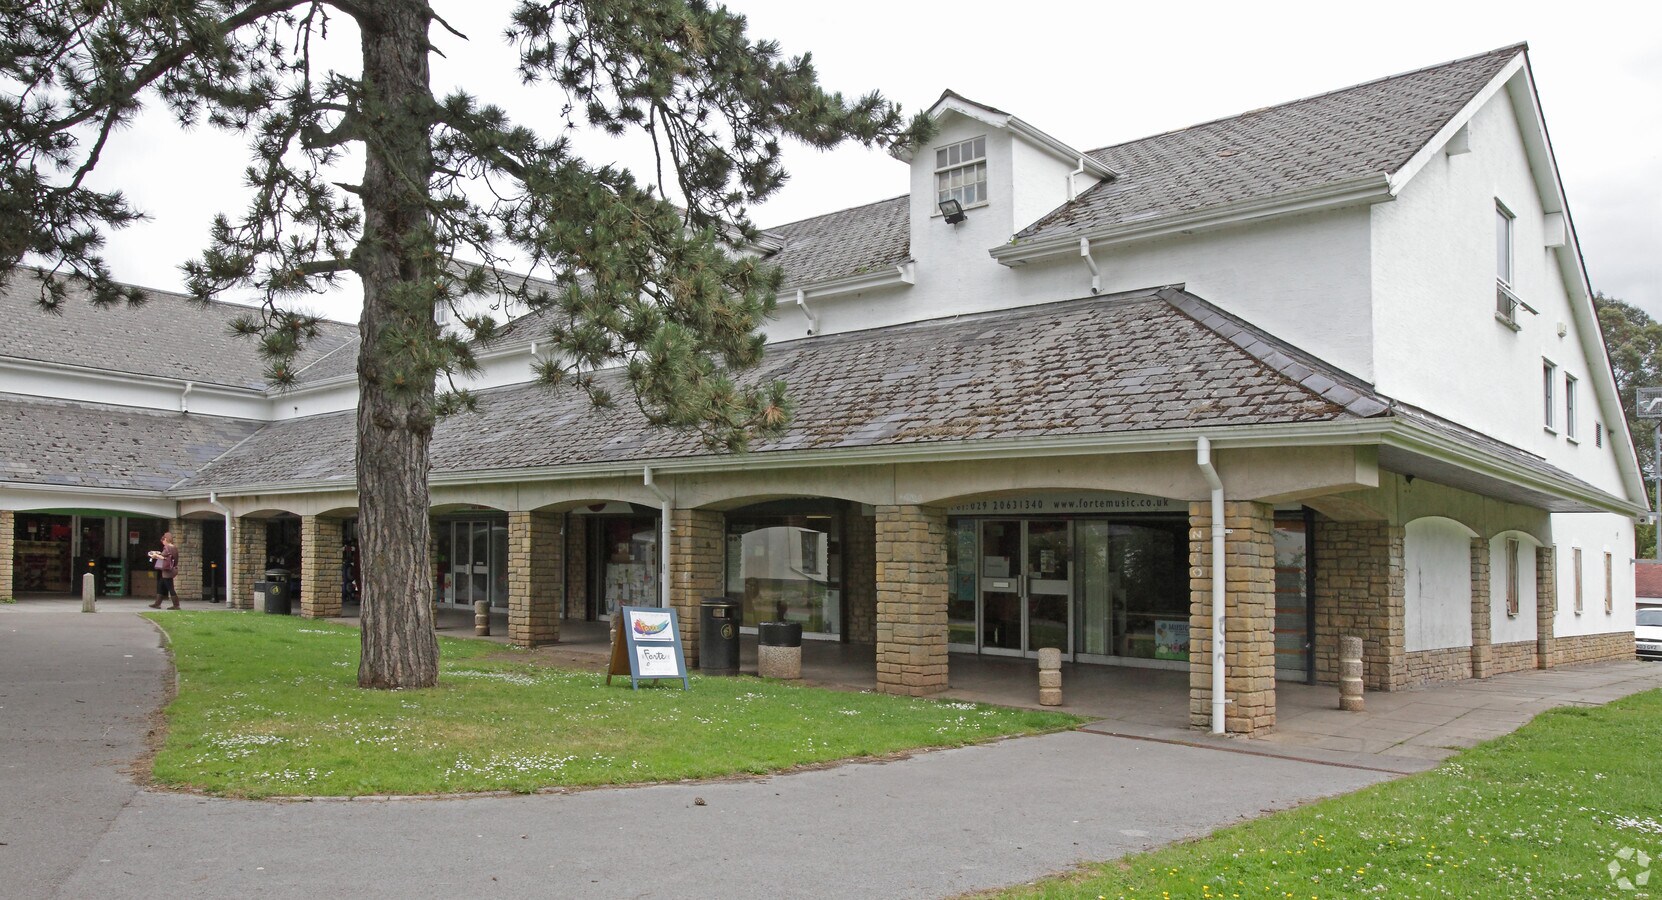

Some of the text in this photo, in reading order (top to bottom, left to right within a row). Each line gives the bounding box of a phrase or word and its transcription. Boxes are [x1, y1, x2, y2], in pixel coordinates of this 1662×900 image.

[993, 500, 1043, 510] 20631340
[1053, 498, 1169, 509] www.fortemusic.co.uk
[643, 649, 667, 664] Forte
